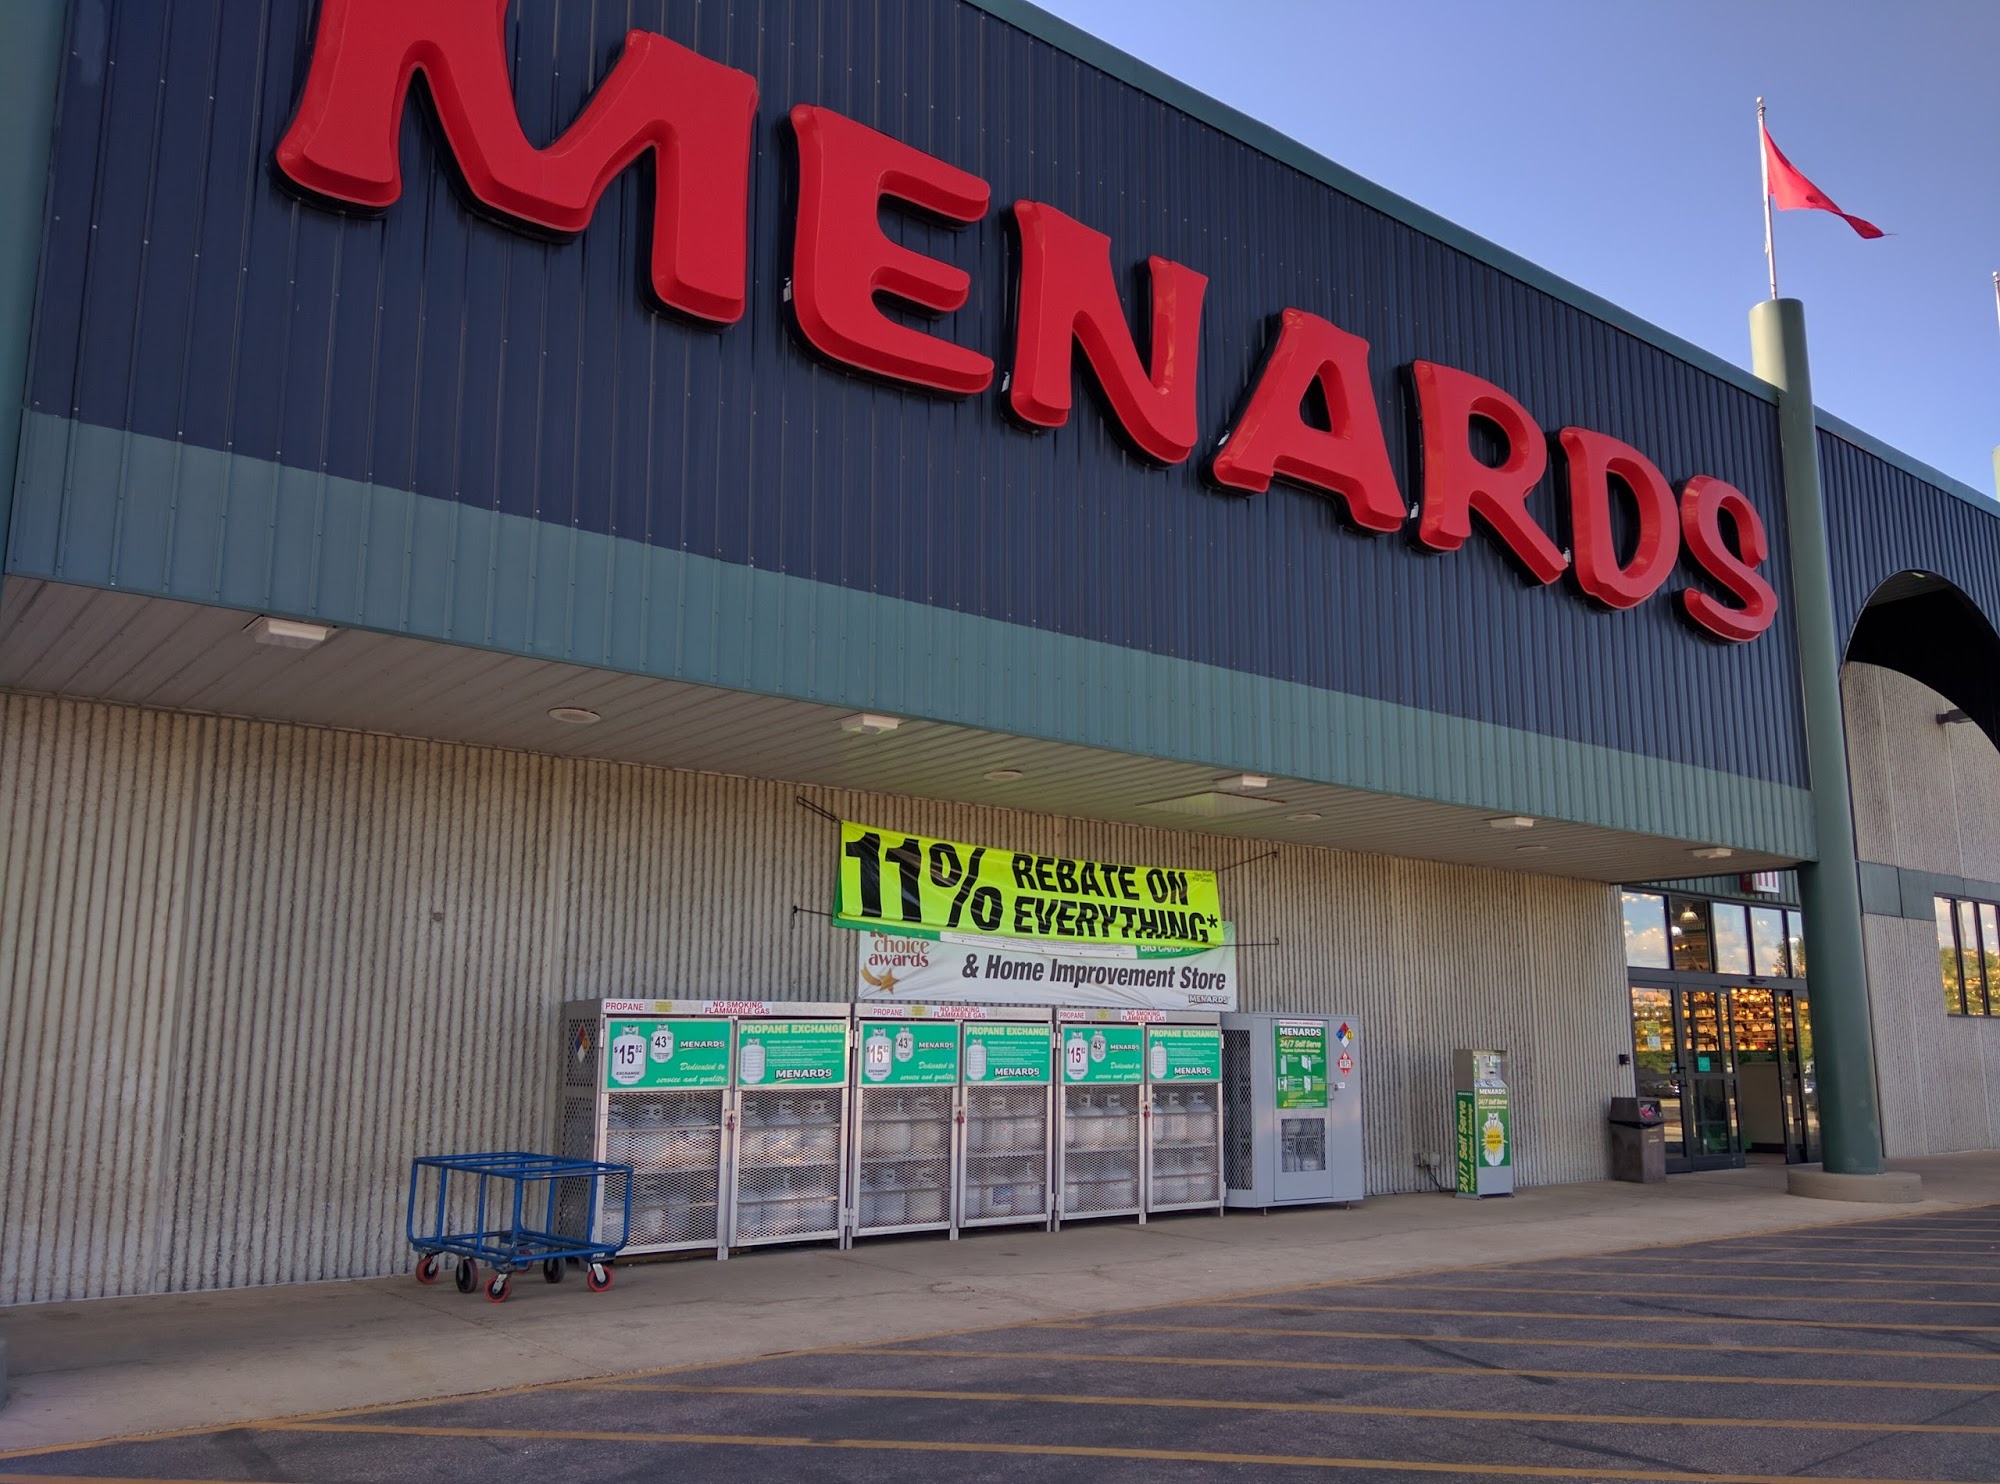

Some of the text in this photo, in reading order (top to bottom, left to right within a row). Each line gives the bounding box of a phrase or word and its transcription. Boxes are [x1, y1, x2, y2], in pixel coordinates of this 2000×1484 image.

[276, 0, 1778, 643] MENARDS
[846, 832, 1003, 931] 11%
[1012, 853, 1188, 905] REBATE ON
[874, 935, 929, 954] choice
[869, 952, 929, 967] awards
[962, 953, 1226, 990] & Home Improvement Store
[1188, 994, 1228, 1004] MENARDS
[605, 1002, 644, 1011] PROPANE
[873, 1008, 903, 1016] PROPANE
[741, 1024, 846, 1034] PROPANE EXCHANGE
[967, 1026, 1050, 1036] PROPANE EXCHANGE
[1150, 1030, 1219, 1038] PROPANE EXCHANGE
[1279, 1028, 1322, 1037] MENARDS
[1280, 1040, 1322, 1048] 24/7 Self Serve
[680, 1062, 716, 1071] Dedicated
[1173, 1067, 1212, 1076] MENARDS
[775, 1069, 832, 1079] MENARDS
[994, 1067, 1040, 1077] MENARDS
[683, 1075, 698, 1083] and
[1459, 1100, 1469, 1193] 24/7 Self Serve
